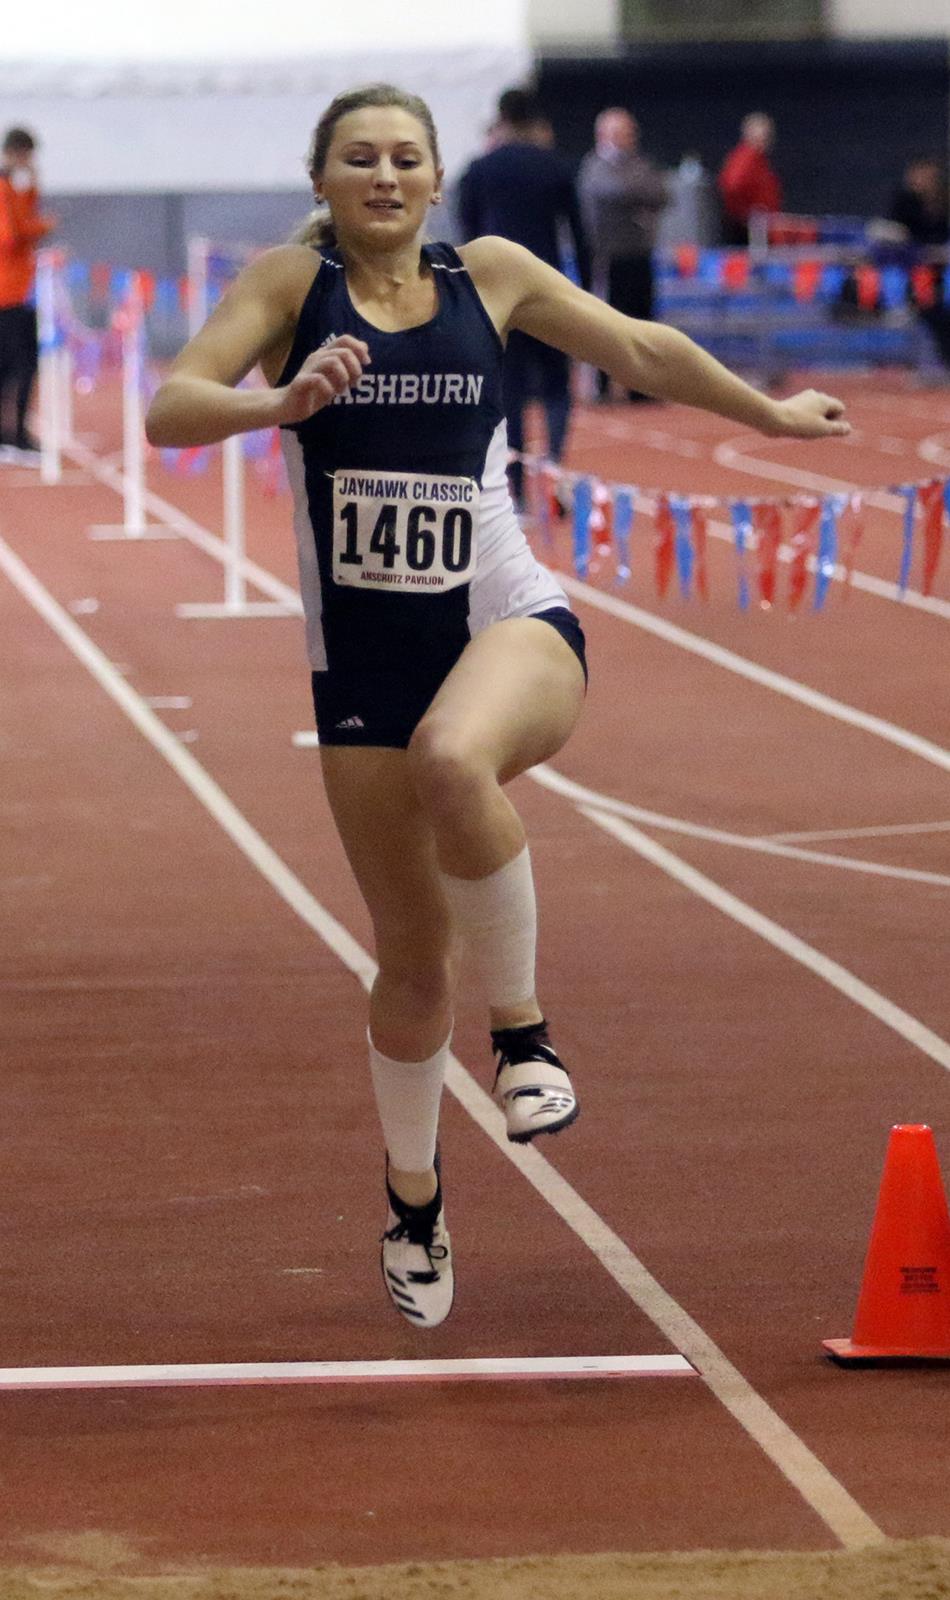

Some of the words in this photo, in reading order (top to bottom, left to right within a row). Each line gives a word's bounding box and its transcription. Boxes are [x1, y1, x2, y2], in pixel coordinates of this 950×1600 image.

[339, 478, 408, 499] JAYHAWK
[412, 481, 473, 502] CLASSIC
[339, 502, 473, 573] 1460
[360, 571, 402, 584] ANSCHUTZ
[404, 574, 444, 585] PAVILION
